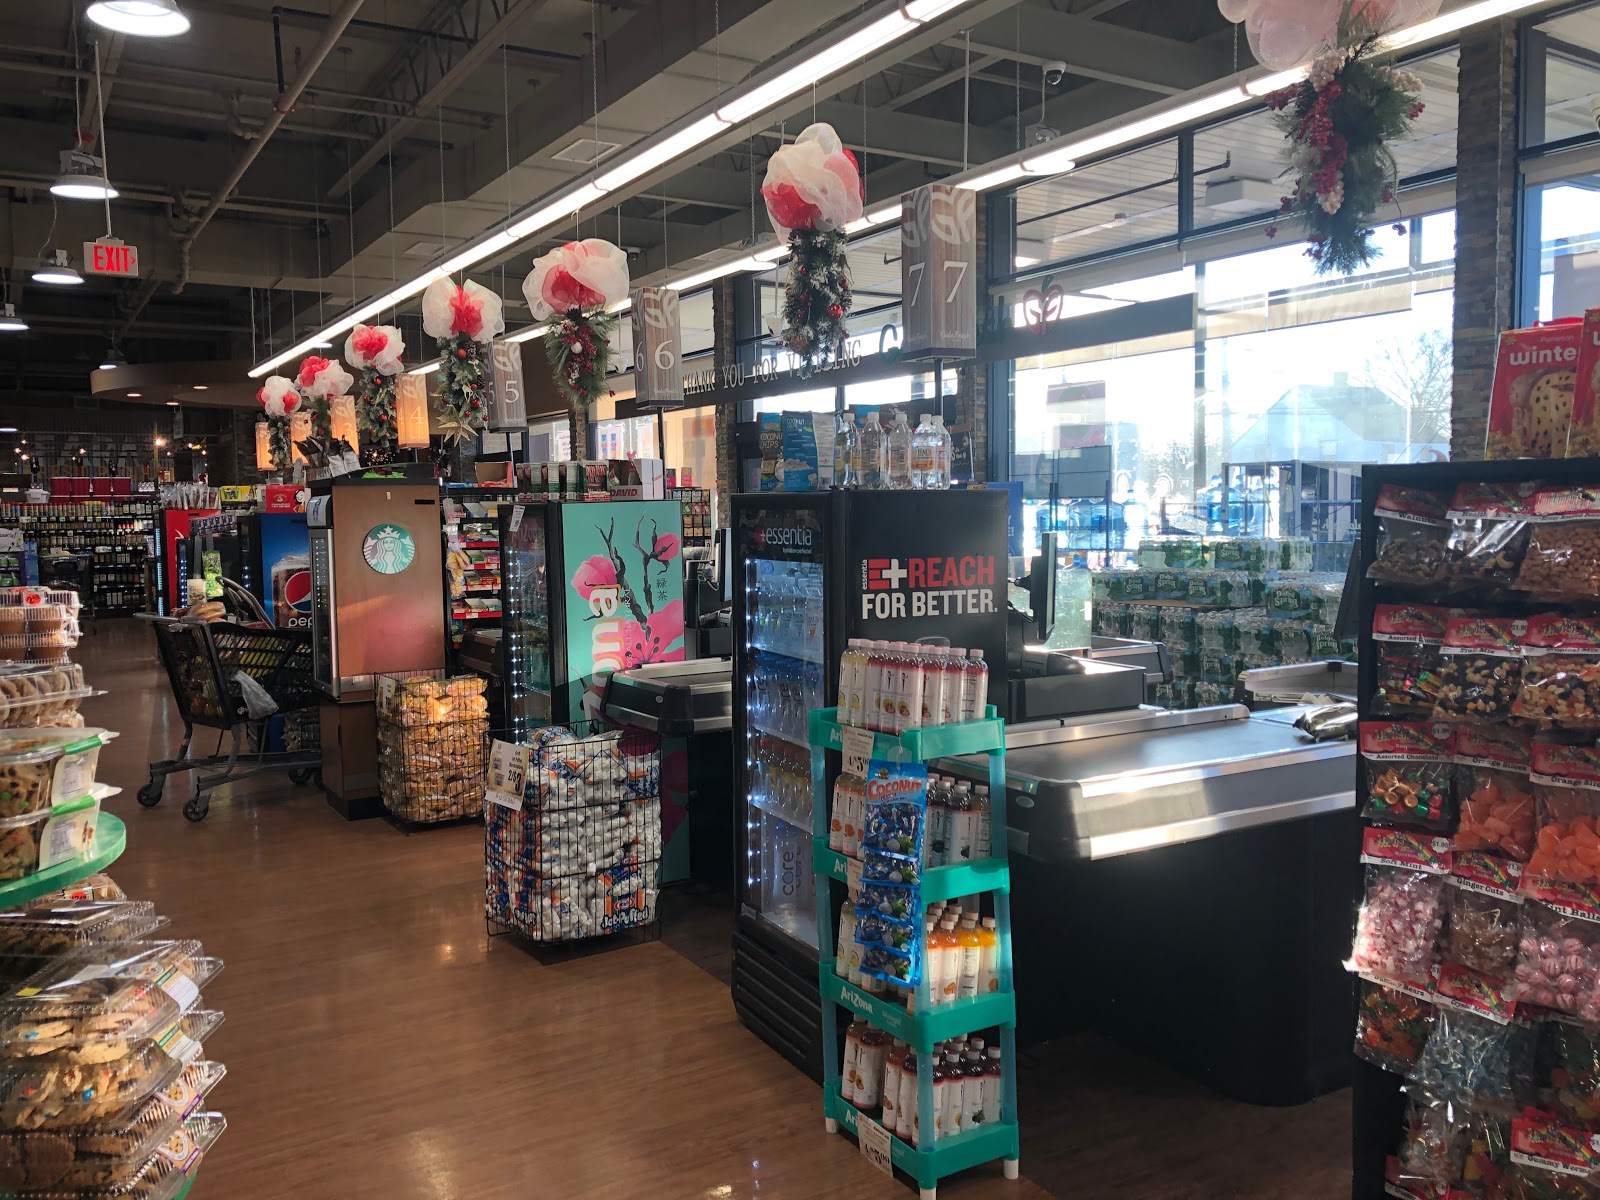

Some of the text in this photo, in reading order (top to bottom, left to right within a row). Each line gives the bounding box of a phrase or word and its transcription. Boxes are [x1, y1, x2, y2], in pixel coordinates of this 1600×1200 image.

[93, 245, 131, 273] EXIT
[908, 261, 926, 308] 7
[943, 260, 969, 304] 7
[636, 340, 645, 372] 6
[654, 339, 676, 371] 6
[1508, 345, 1578, 366] winte
[682, 369, 716, 395] HANK
[721, 363, 746, 389] YOU
[752, 359, 779, 384] FOR
[488, 381, 496, 405] 5
[505, 380, 520, 404] 5
[410, 405, 425, 425] 4
[342, 422, 354, 440] 3
[760, 432, 783, 441] COCONU
[610, 488, 638, 497] DAVID
[765, 525, 812, 546] essentia
[908, 555, 996, 589] REACH
[624, 588, 632, 632] NATURAL
[861, 588, 999, 620] FOR BETTER.
[1274, 597, 1299, 608] Spring
[288, 617, 313, 628] pep
[867, 779, 922, 802] COCONUT
[1551, 775, 1600, 788] Orange Slic
[782, 851, 794, 896] core
[1400, 861, 1423, 870] Mint
[1456, 878, 1504, 897] Ginger Cuts
[600, 906, 649, 928] Jet-Puffed
[1571, 909, 1600, 920] Balls
[841, 986, 873, 1015] AriZona
[1403, 984, 1425, 997] Bears
